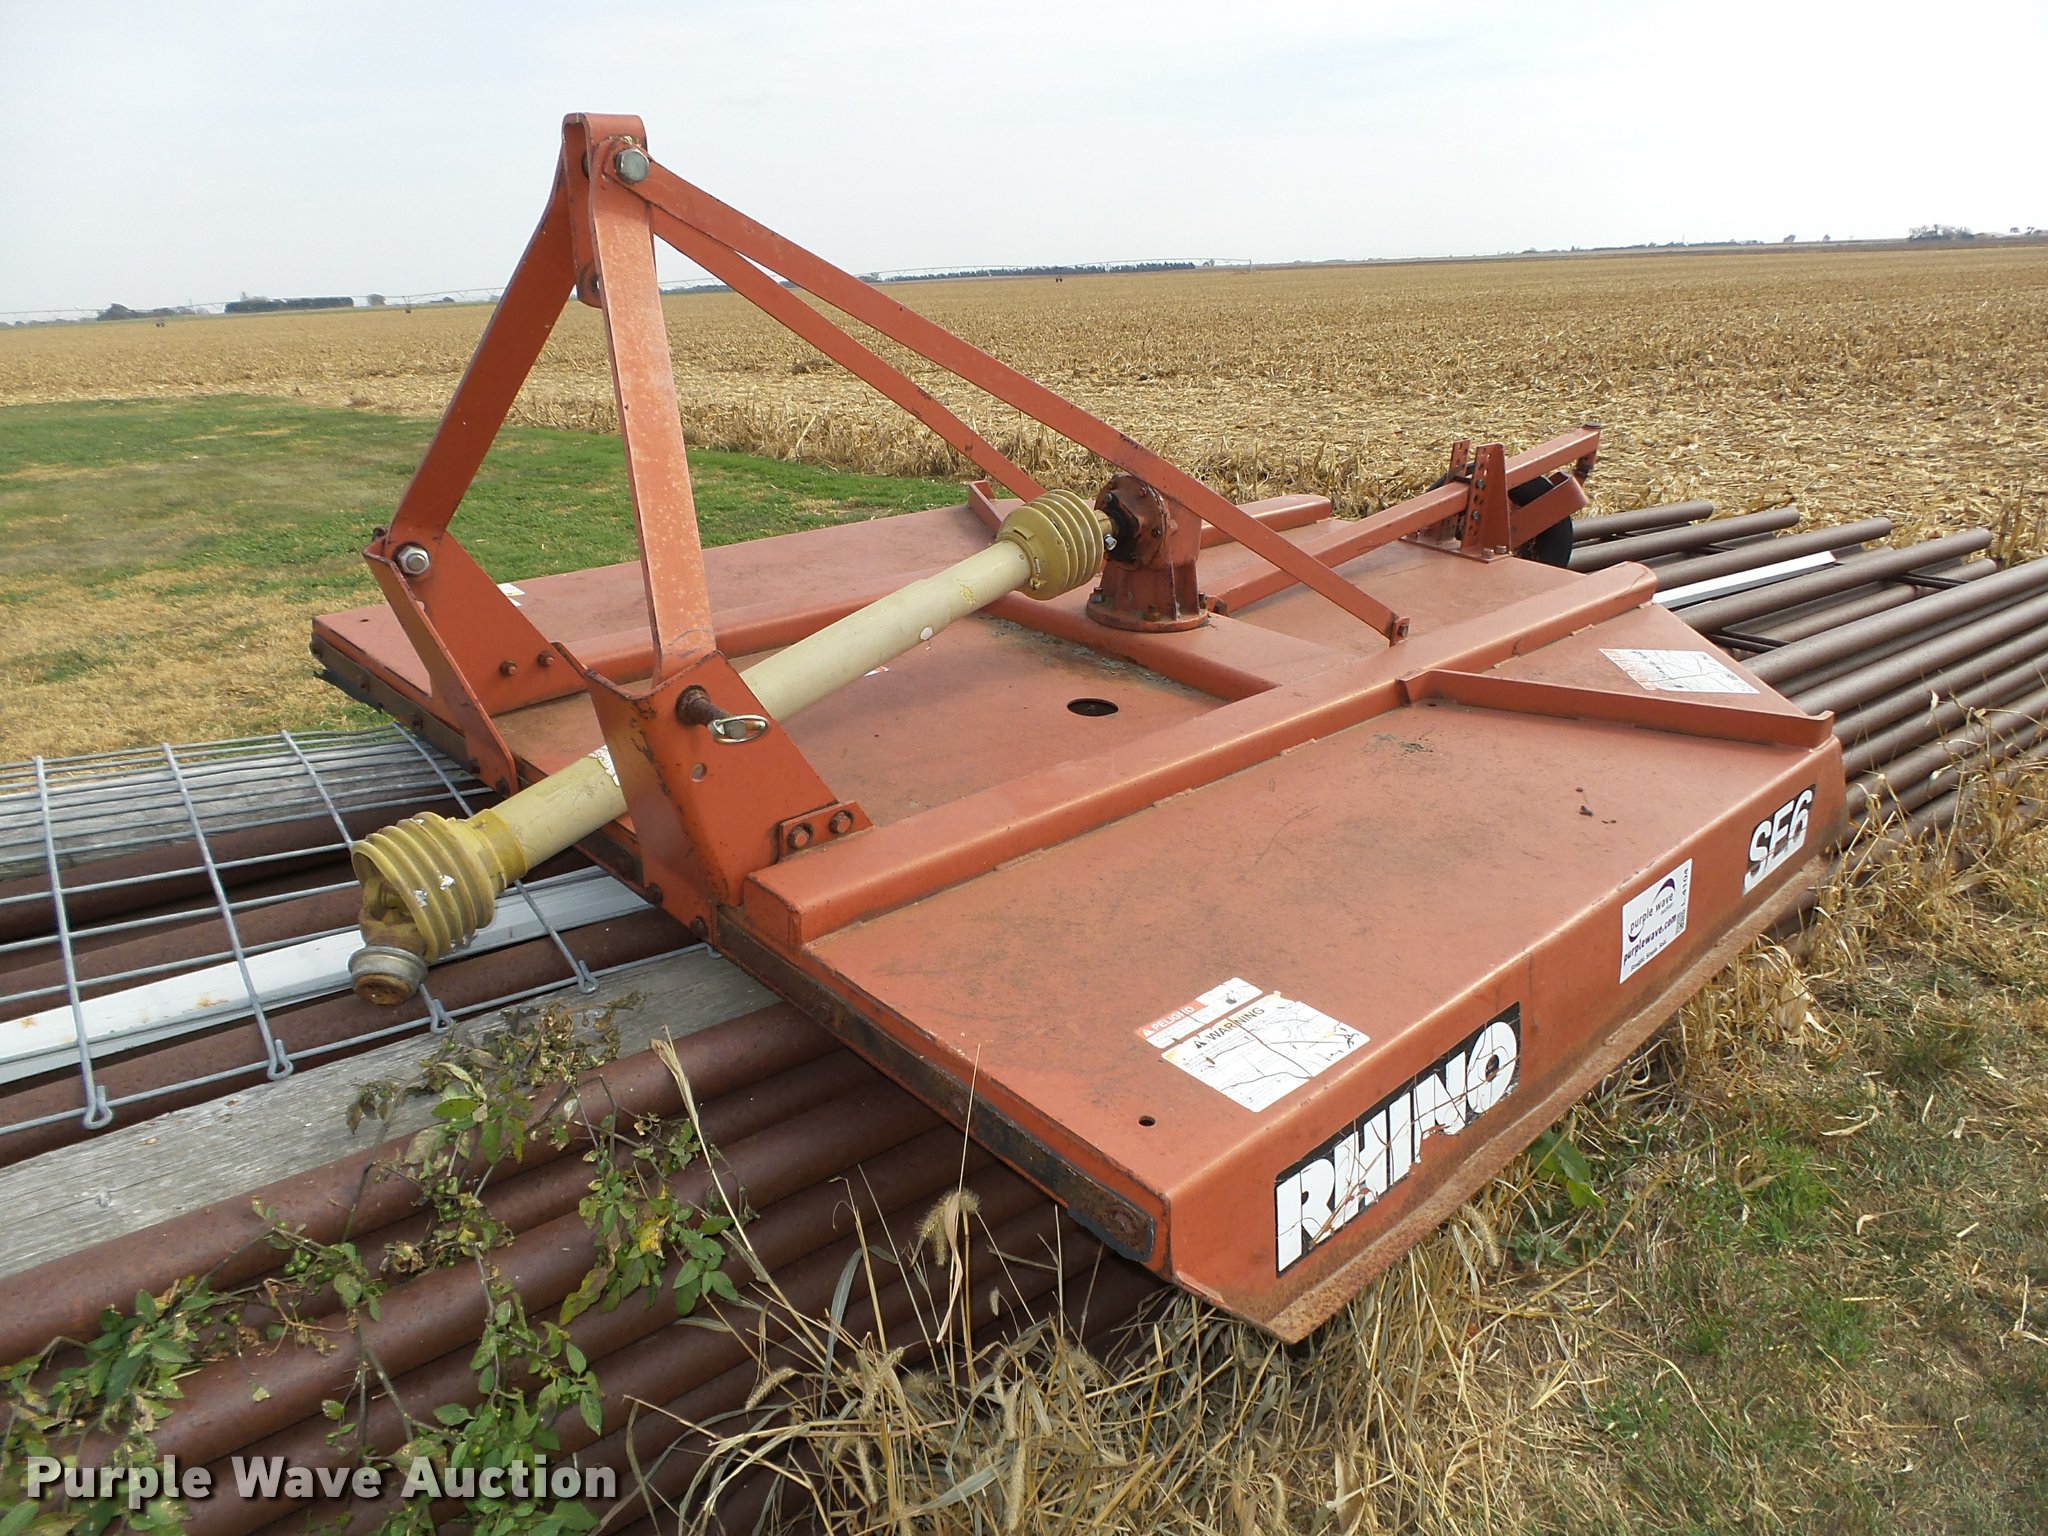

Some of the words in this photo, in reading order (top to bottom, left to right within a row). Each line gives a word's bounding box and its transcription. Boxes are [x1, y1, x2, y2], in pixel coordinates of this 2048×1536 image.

[1744, 789, 1813, 891] SE6
[1630, 906, 1654, 933] purple
[1655, 892, 1674, 912] wave
[1623, 913, 1677, 966] purplewave.com
[1205, 1007, 1265, 1040] WARNING
[1276, 1021, 1517, 1273] RHINO
